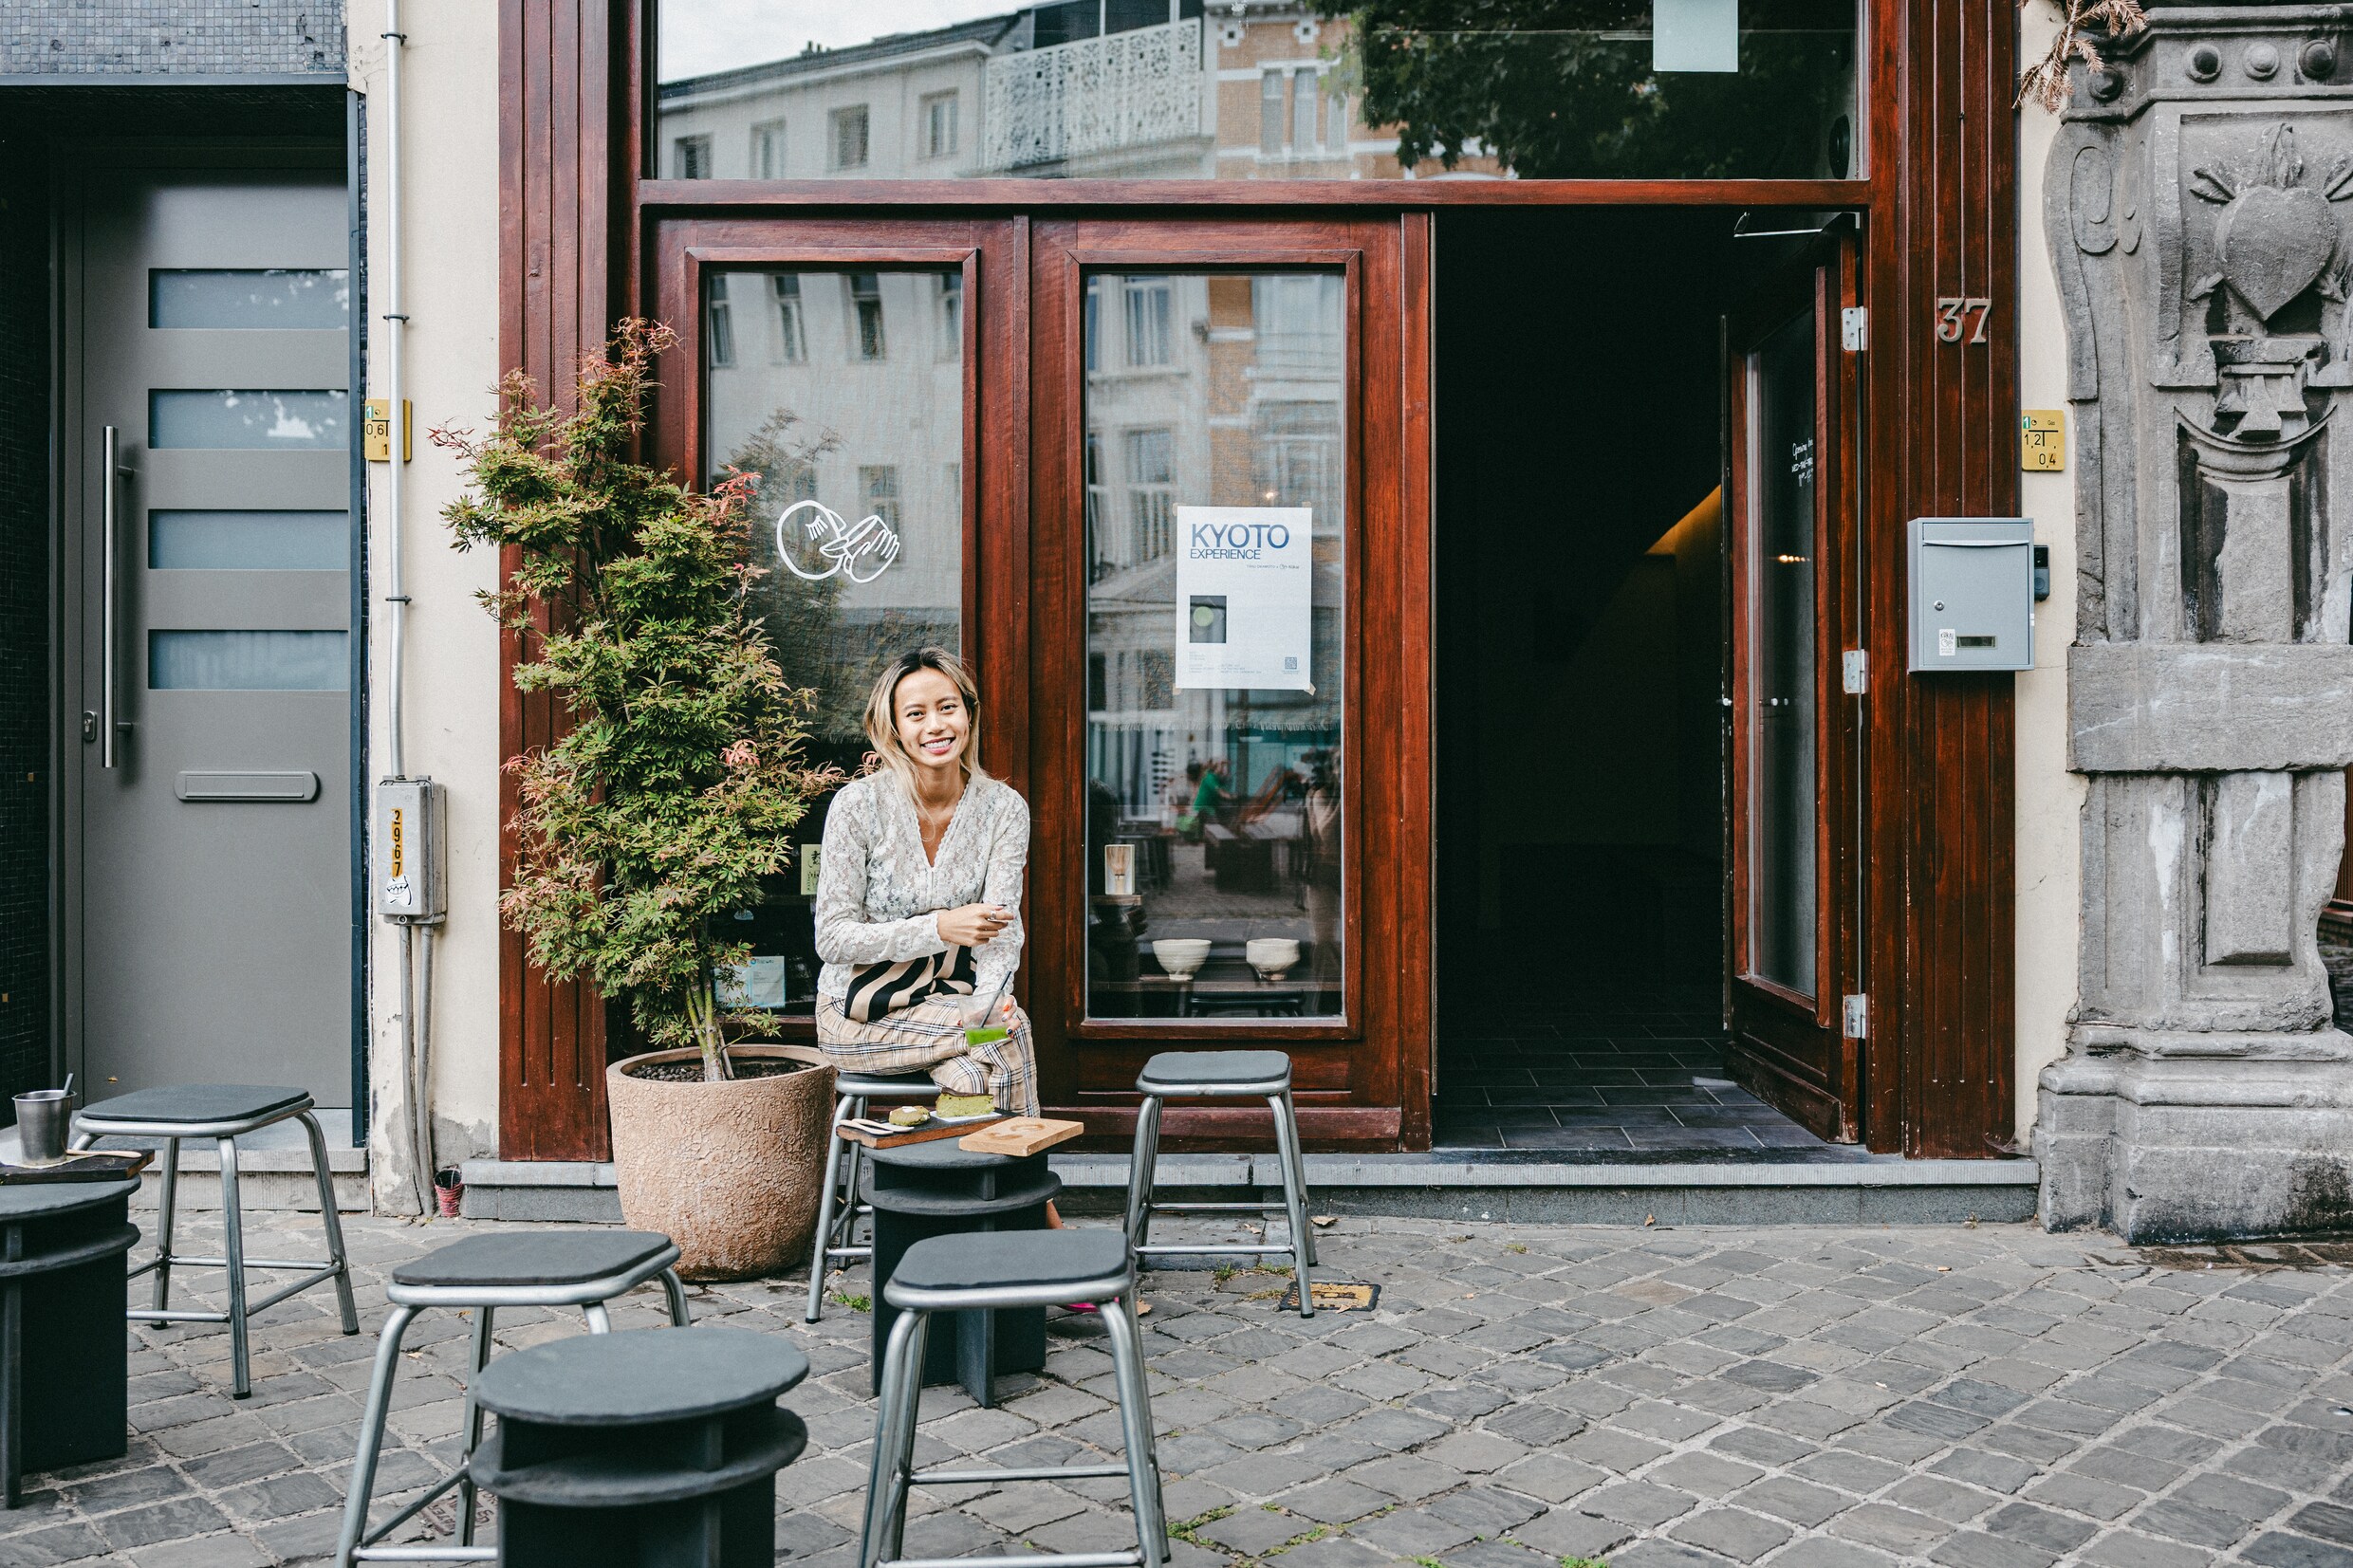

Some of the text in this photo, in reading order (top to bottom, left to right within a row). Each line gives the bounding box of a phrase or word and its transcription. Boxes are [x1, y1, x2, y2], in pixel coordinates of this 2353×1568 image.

[1936, 297, 1992, 343] 37
[366, 406, 372, 417] 1
[2023, 416, 2029, 429] 1
[1192, 524, 1289, 548] KYOTO
[1190, 548, 1261, 560] EXPERIENCE
[393, 809, 401, 876] 2967
